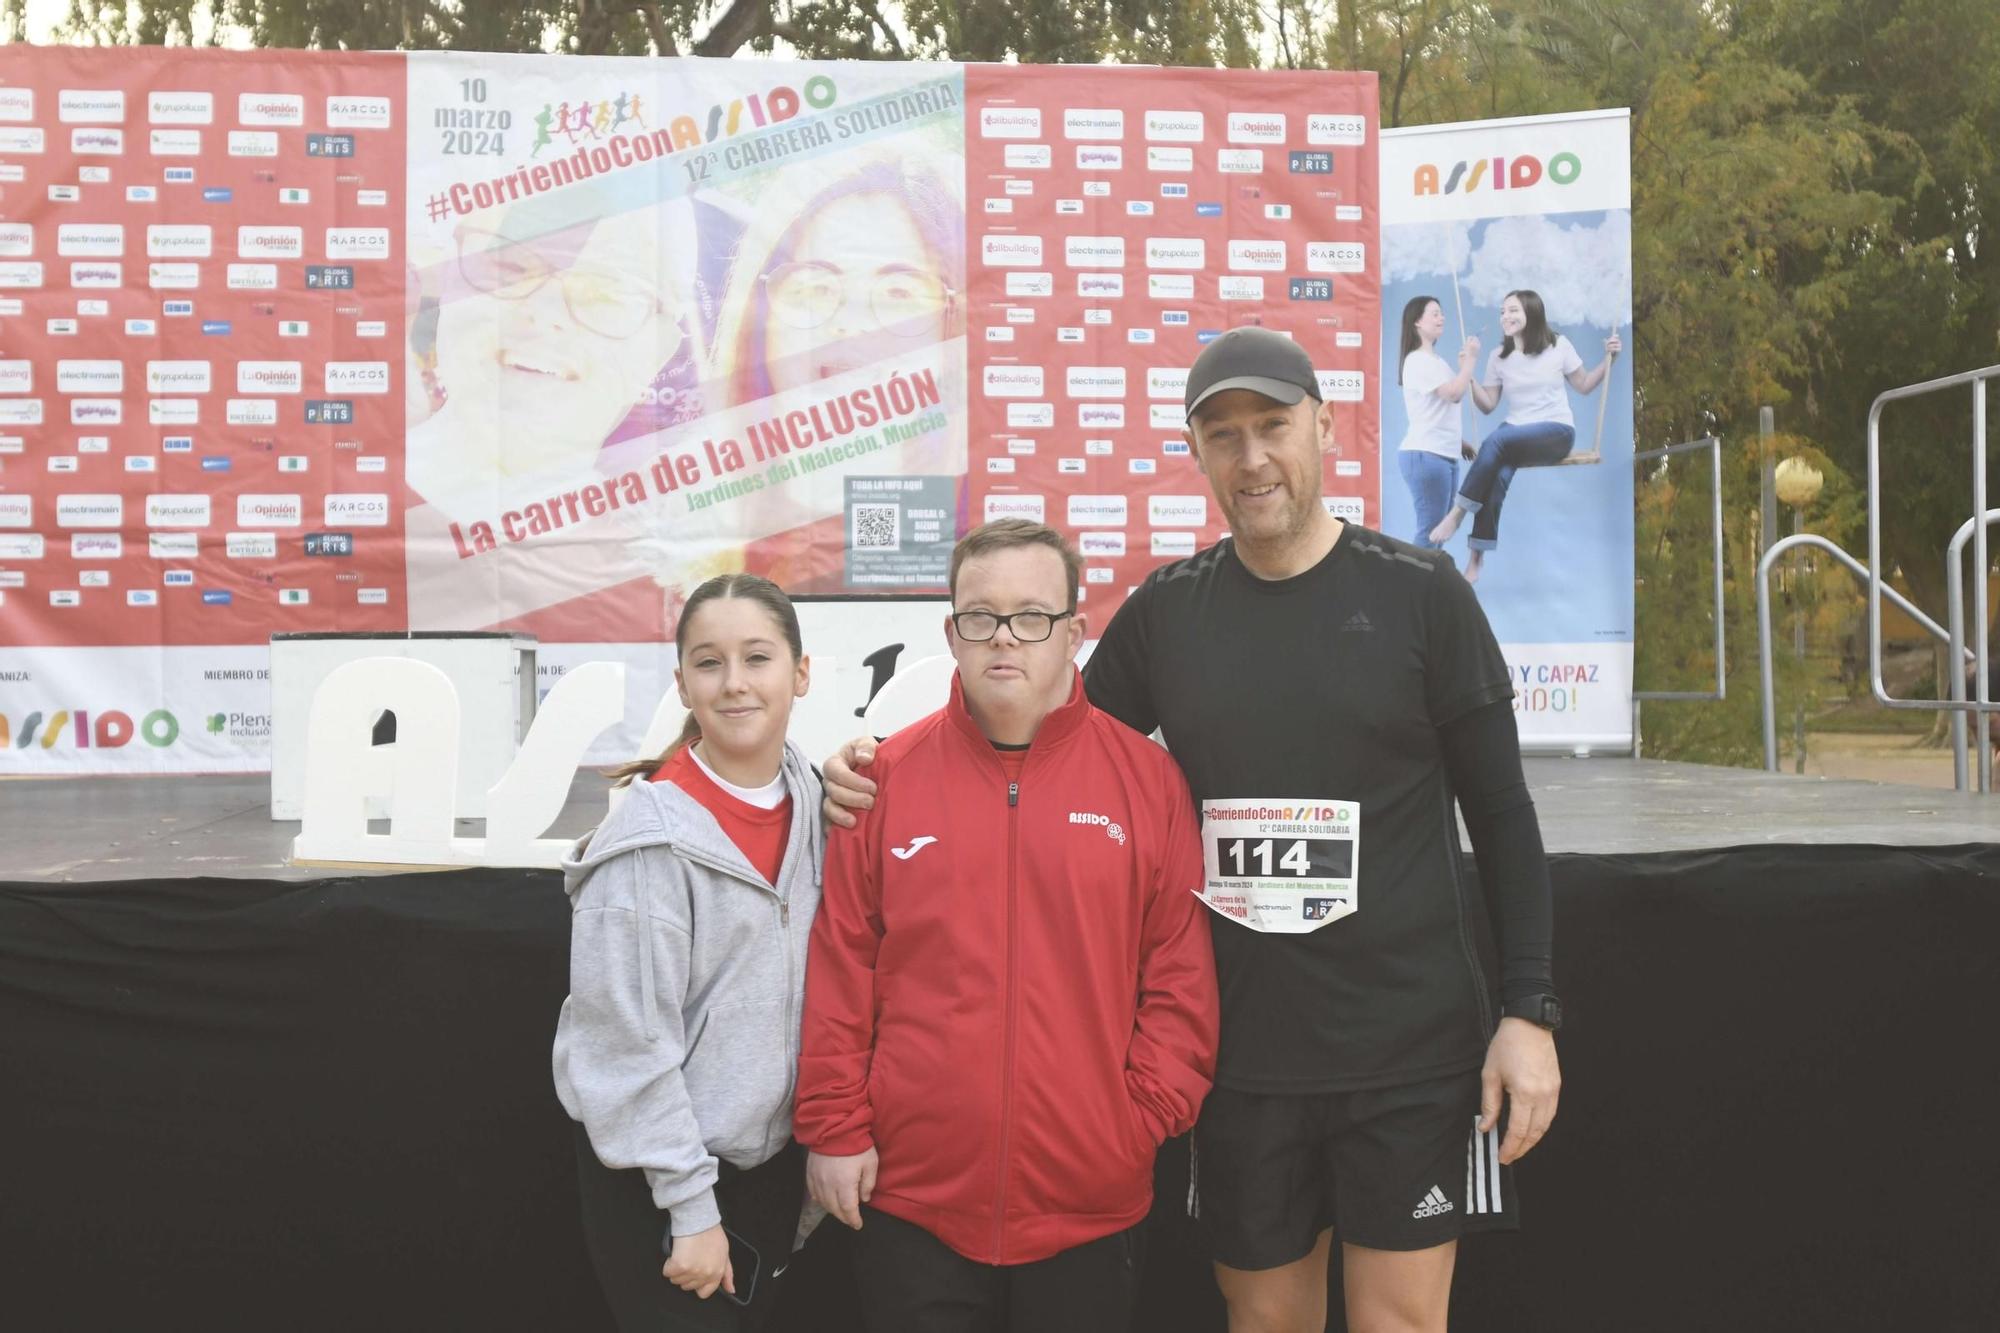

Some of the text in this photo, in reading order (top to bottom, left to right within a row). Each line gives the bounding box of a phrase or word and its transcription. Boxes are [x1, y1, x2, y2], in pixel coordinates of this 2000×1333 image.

[460, 78, 486, 102] 10
[434, 107, 511, 131] marzo
[724, 120, 832, 171] CARRERA
[838, 83, 957, 139] SOLIDARIA
[441, 131, 504, 156] 2024
[1414, 151, 1582, 196] ASSIDO
[1320, 375, 1361, 388] ARCOS
[448, 521, 496, 560] La
[501, 471, 647, 543] carrera
[651, 452, 701, 497] de
[707, 438, 745, 478] la
[745, 368, 941, 461] INCLUSIÓN
[685, 411, 947, 512] Jardines del Malecón, Murcia
[1327, 504, 1361, 517] RCOS
[204, 670, 253, 680] MIEMBRO
[1520, 665, 1531, 683] Y
[1537, 664, 1599, 683] CAPAZ
[230, 727, 272, 737] inclusió
[1069, 812, 1109, 826] ASSIDO
[1272, 824, 1307, 833] CARRERA
[1308, 824, 1350, 834] SOLIDARIA
[1229, 839, 1311, 876] 114
[1413, 1201, 1454, 1219] adidas
